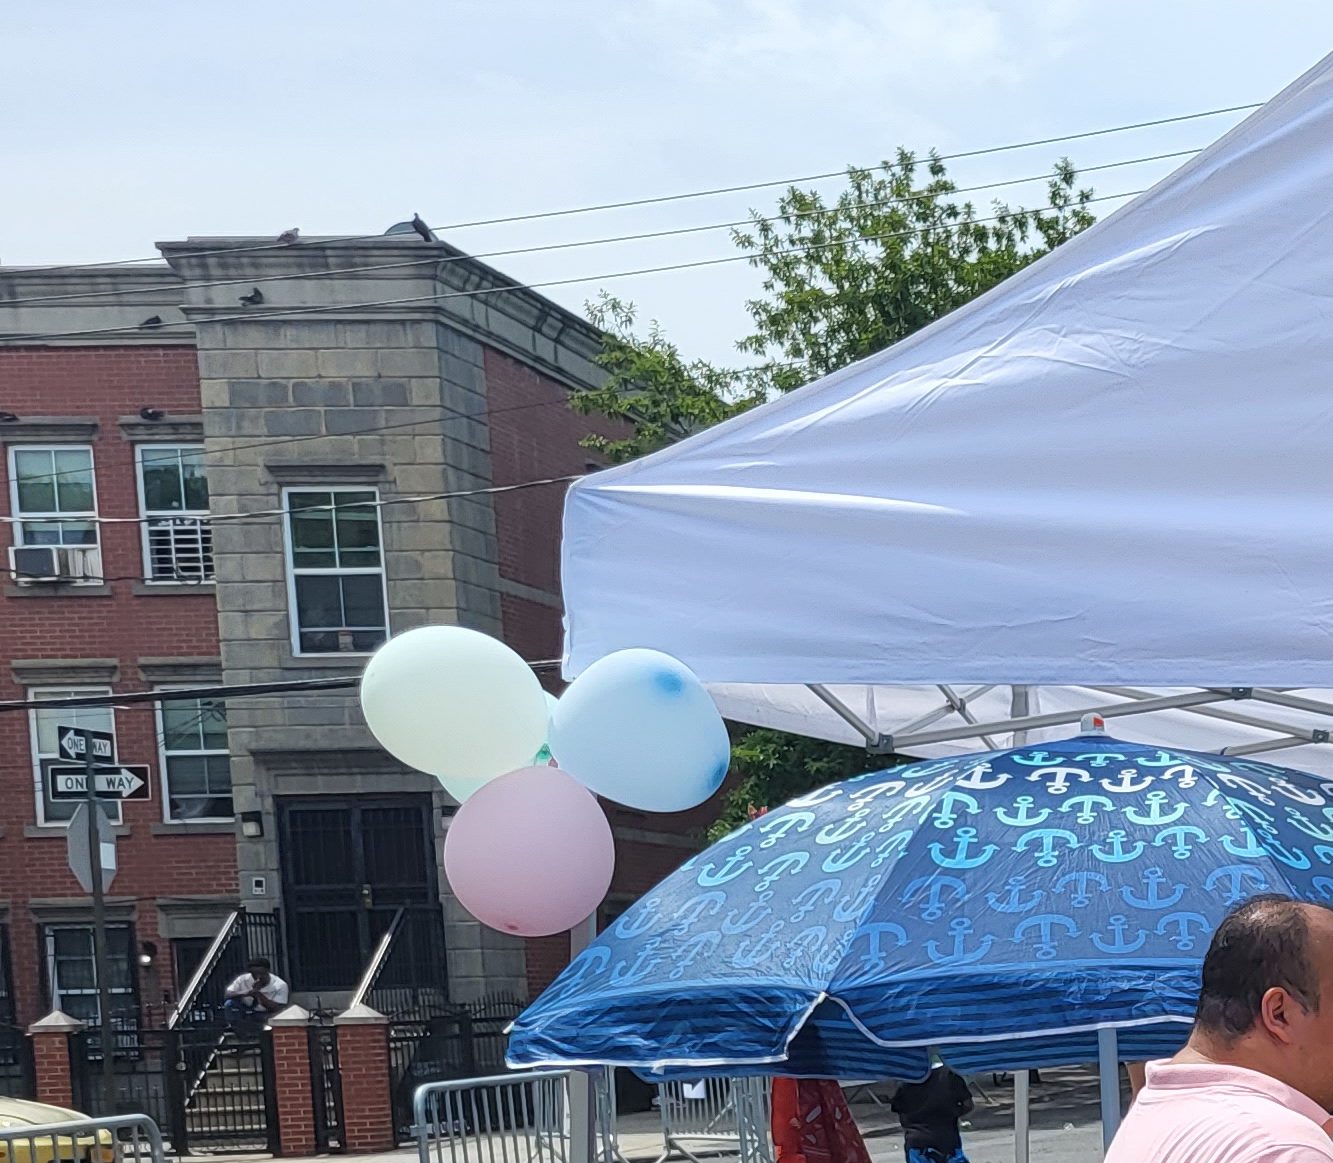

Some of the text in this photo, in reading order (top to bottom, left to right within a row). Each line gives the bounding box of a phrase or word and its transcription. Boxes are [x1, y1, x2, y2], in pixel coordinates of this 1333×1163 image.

[67, 736, 86, 752] ONE
[65, 777, 134, 790] ON WAY
